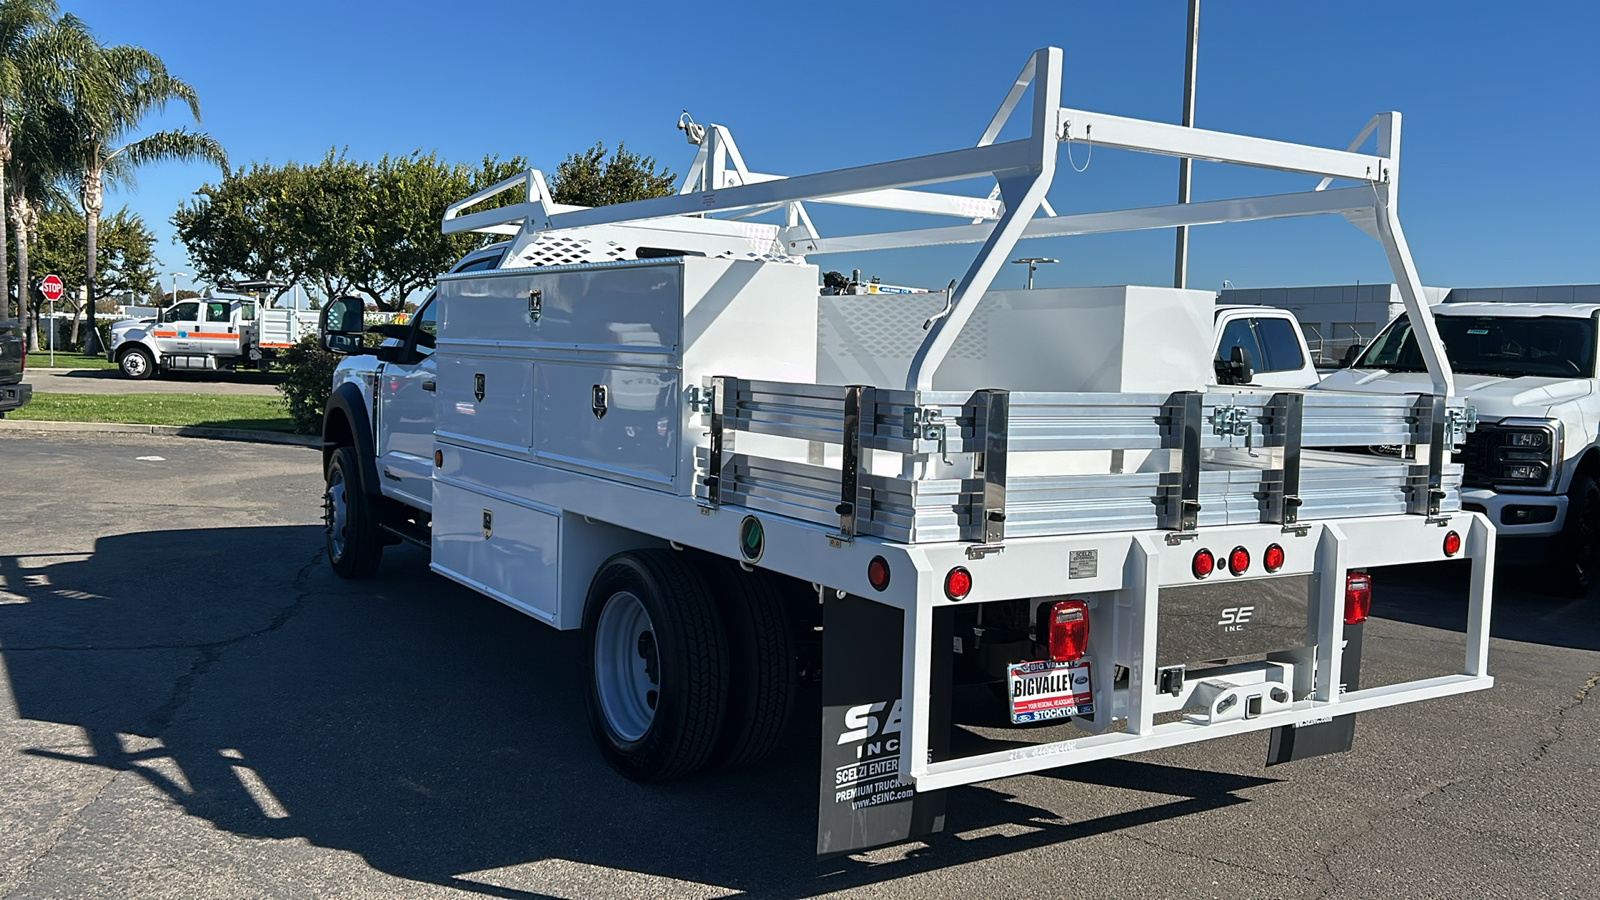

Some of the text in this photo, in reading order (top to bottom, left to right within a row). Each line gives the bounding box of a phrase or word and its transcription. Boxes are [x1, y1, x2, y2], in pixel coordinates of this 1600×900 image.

[44, 282, 61, 293] STOP
[1218, 606, 1254, 625] SE
[1030, 663, 1044, 671] BIG
[1014, 673, 1074, 697] BIGVALLEY
[1033, 706, 1078, 720] STOCKTON
[836, 765, 867, 784] SCELZI
[836, 784, 873, 803] PREMIUM
[874, 778, 900, 792] TRUCK
[852, 789, 913, 810] www.SEINC.com
